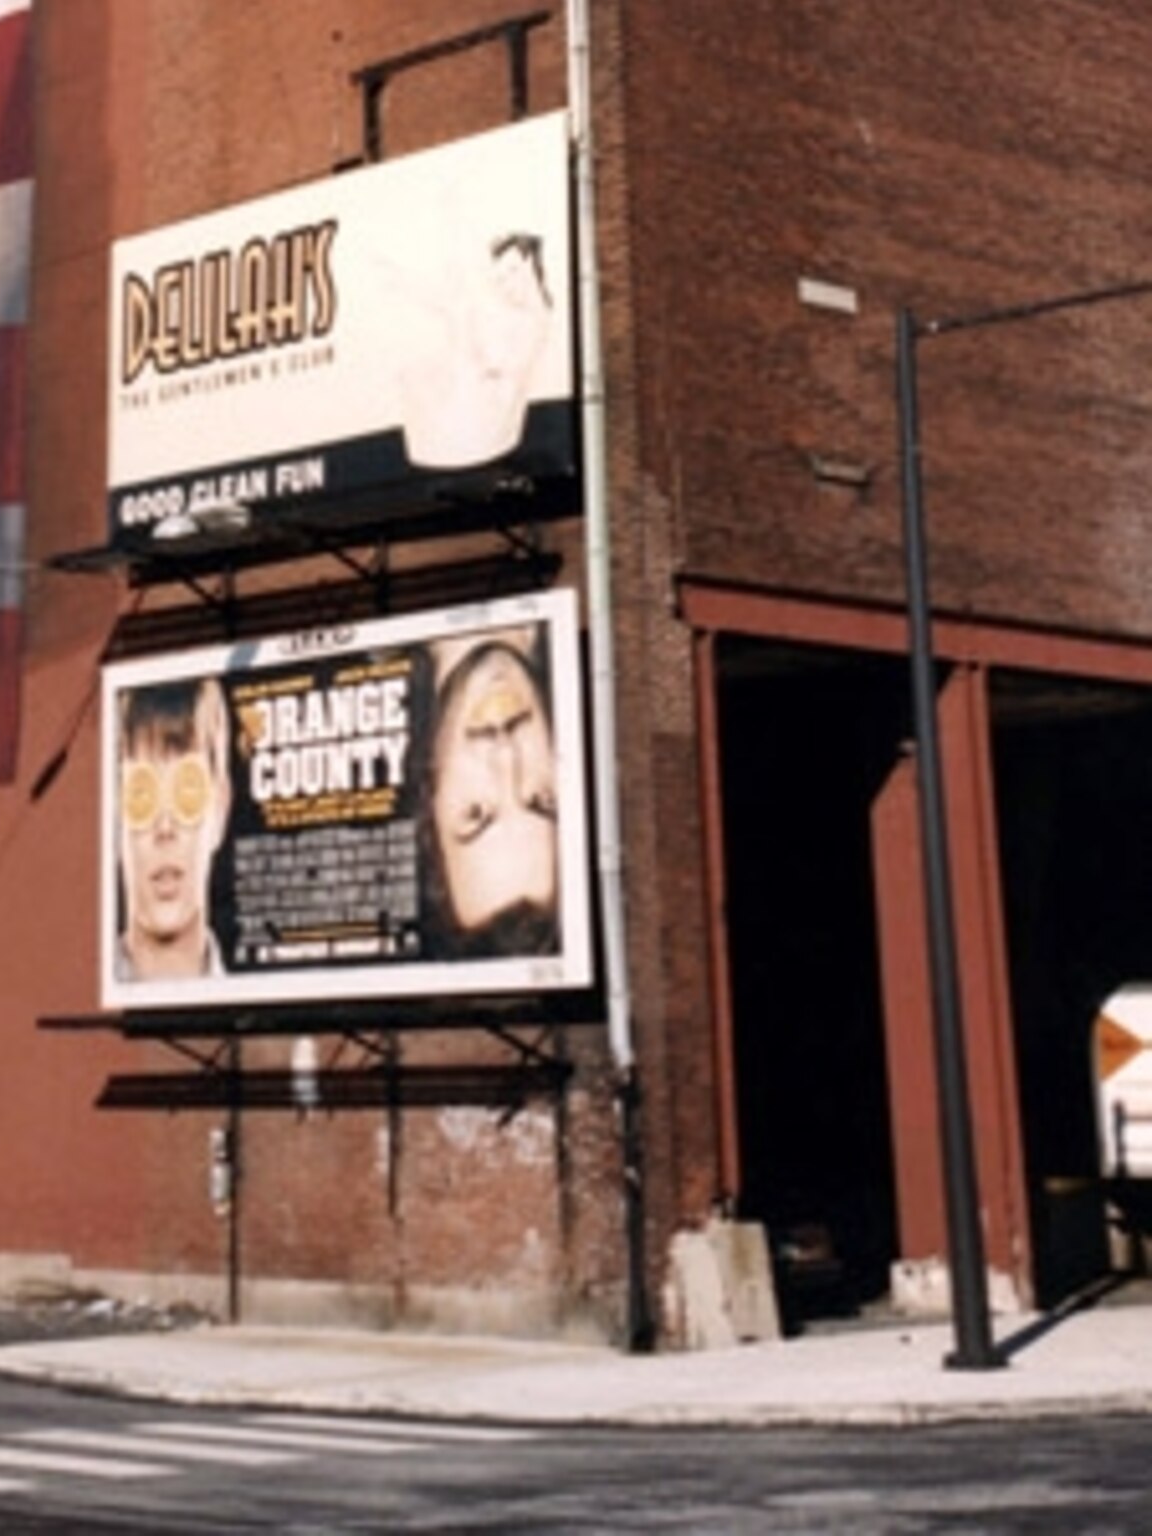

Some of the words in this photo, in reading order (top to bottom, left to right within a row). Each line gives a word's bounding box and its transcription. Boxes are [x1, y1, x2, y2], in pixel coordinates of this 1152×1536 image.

[122, 216, 338, 386] DELILAH'S
[119, 484, 186, 527] GOOD
[189, 468, 269, 511] CLEAN
[274, 455, 326, 497] FUN
[249, 730, 410, 802] COUNTY
